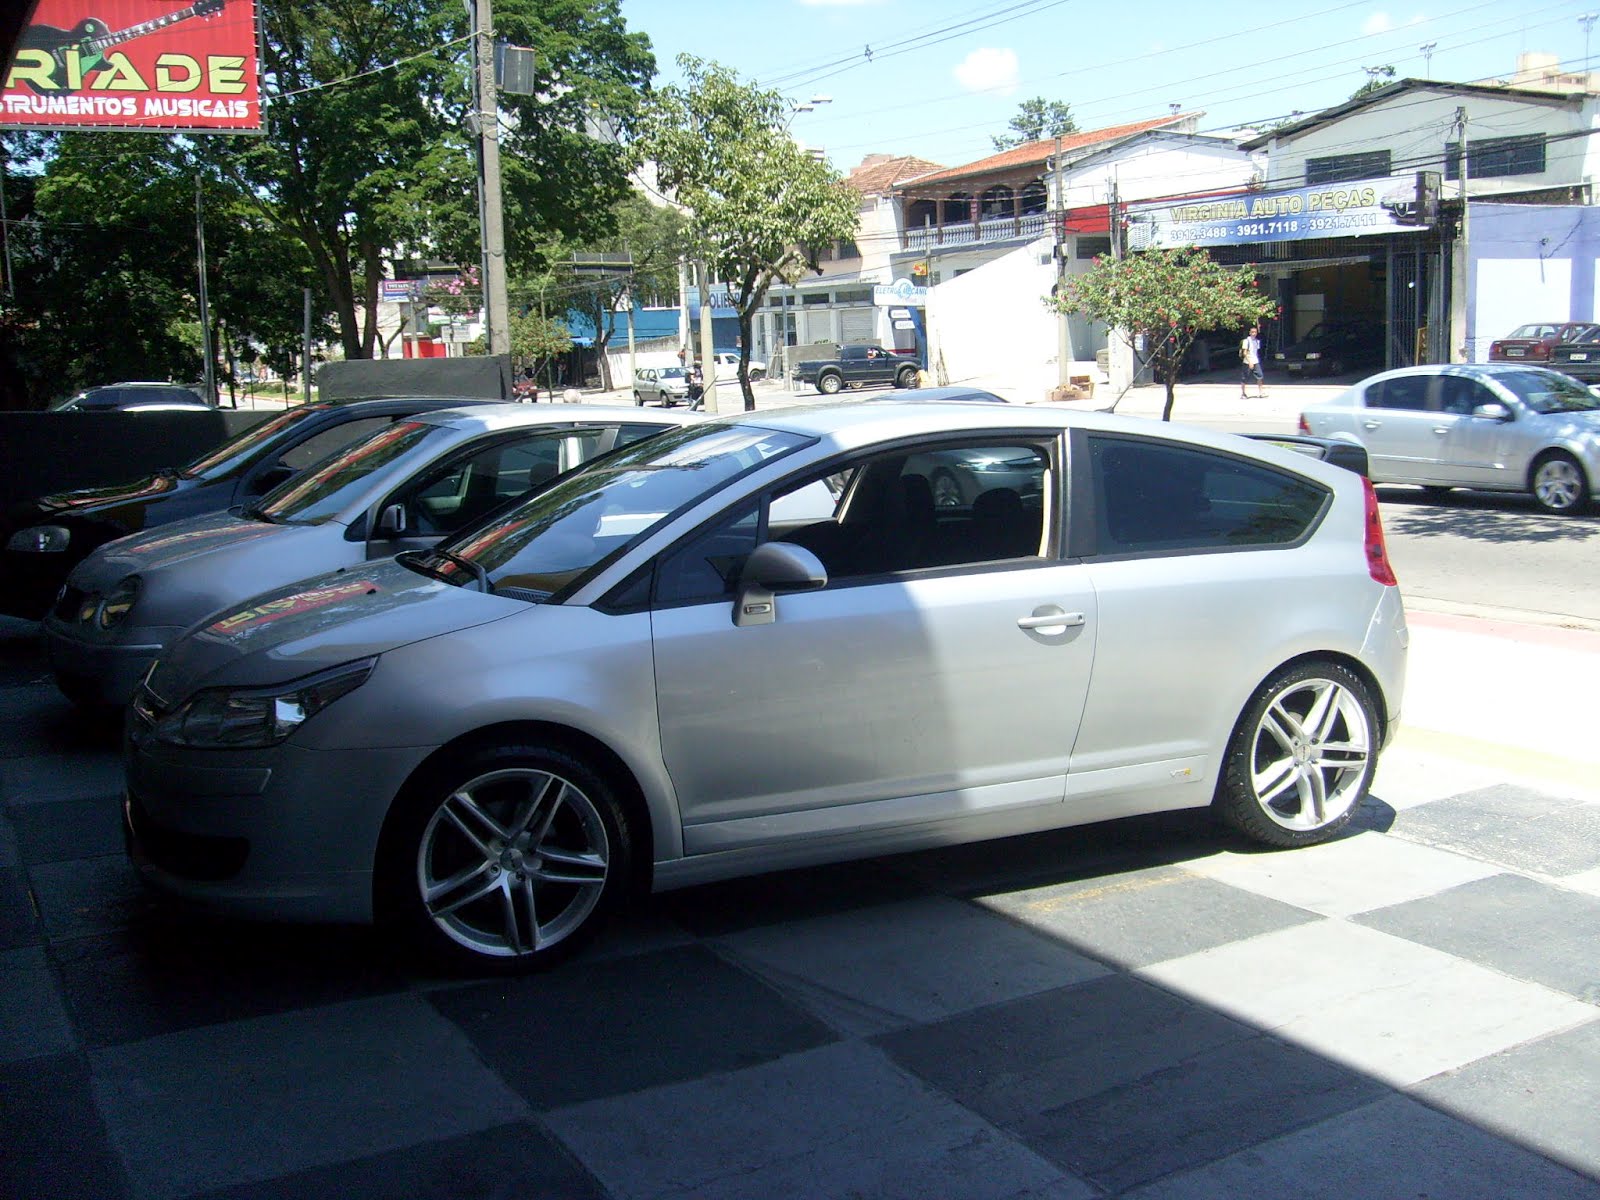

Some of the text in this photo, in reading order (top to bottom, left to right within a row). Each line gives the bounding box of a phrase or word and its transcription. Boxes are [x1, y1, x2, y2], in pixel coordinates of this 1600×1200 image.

[144, 97, 249, 118] MUSICAIS
[1169, 187, 1376, 224] VIRGINIA AUTO PEÇAS
[1170, 226, 1228, 241] 3912.3488
[1237, 220, 1298, 236] 3921.7118
